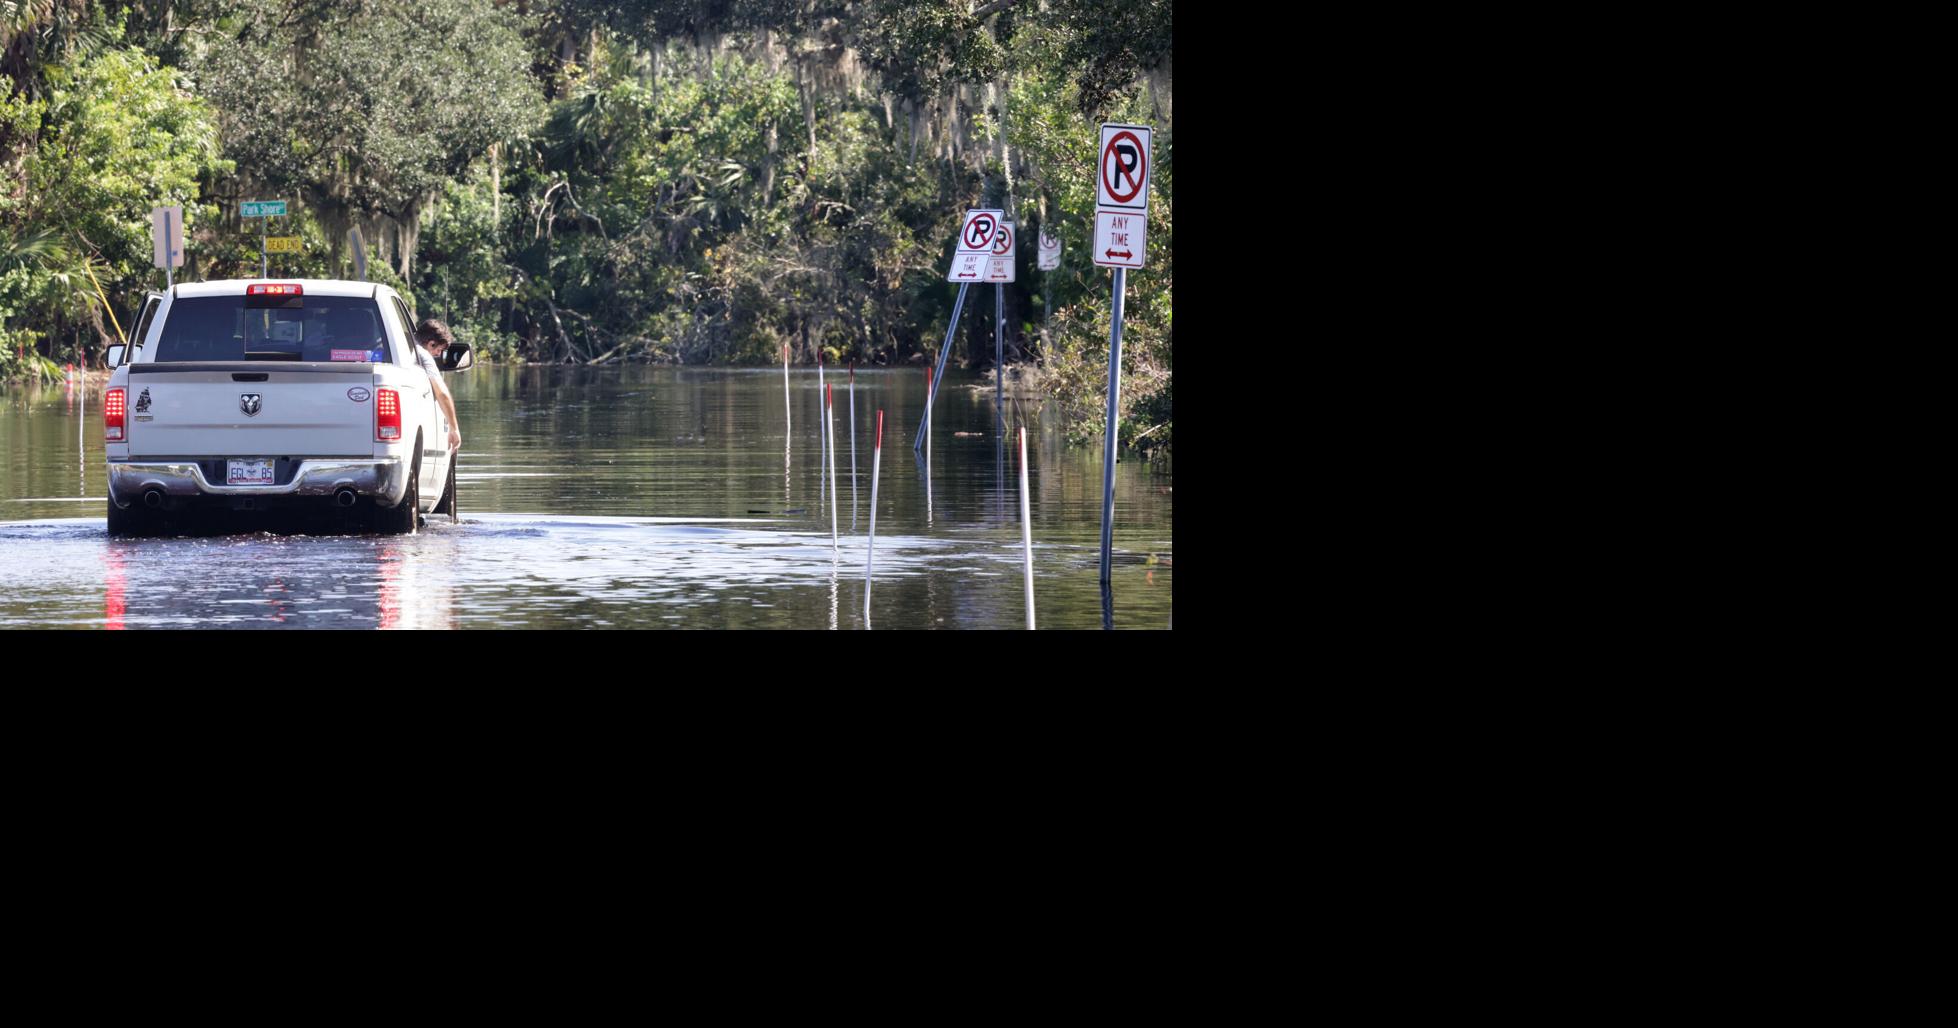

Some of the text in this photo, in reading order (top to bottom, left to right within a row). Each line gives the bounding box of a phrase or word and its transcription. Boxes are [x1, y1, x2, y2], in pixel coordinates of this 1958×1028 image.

[1114, 144, 1138, 189] P
[243, 204, 258, 215] Park
[260, 203, 280, 215] Shore
[1111, 216, 1128, 229] ANY
[971, 220, 991, 243] P
[268, 239, 299, 250] DEAD END
[1111, 232, 1129, 246] TIME
[231, 467, 247, 480] EGL
